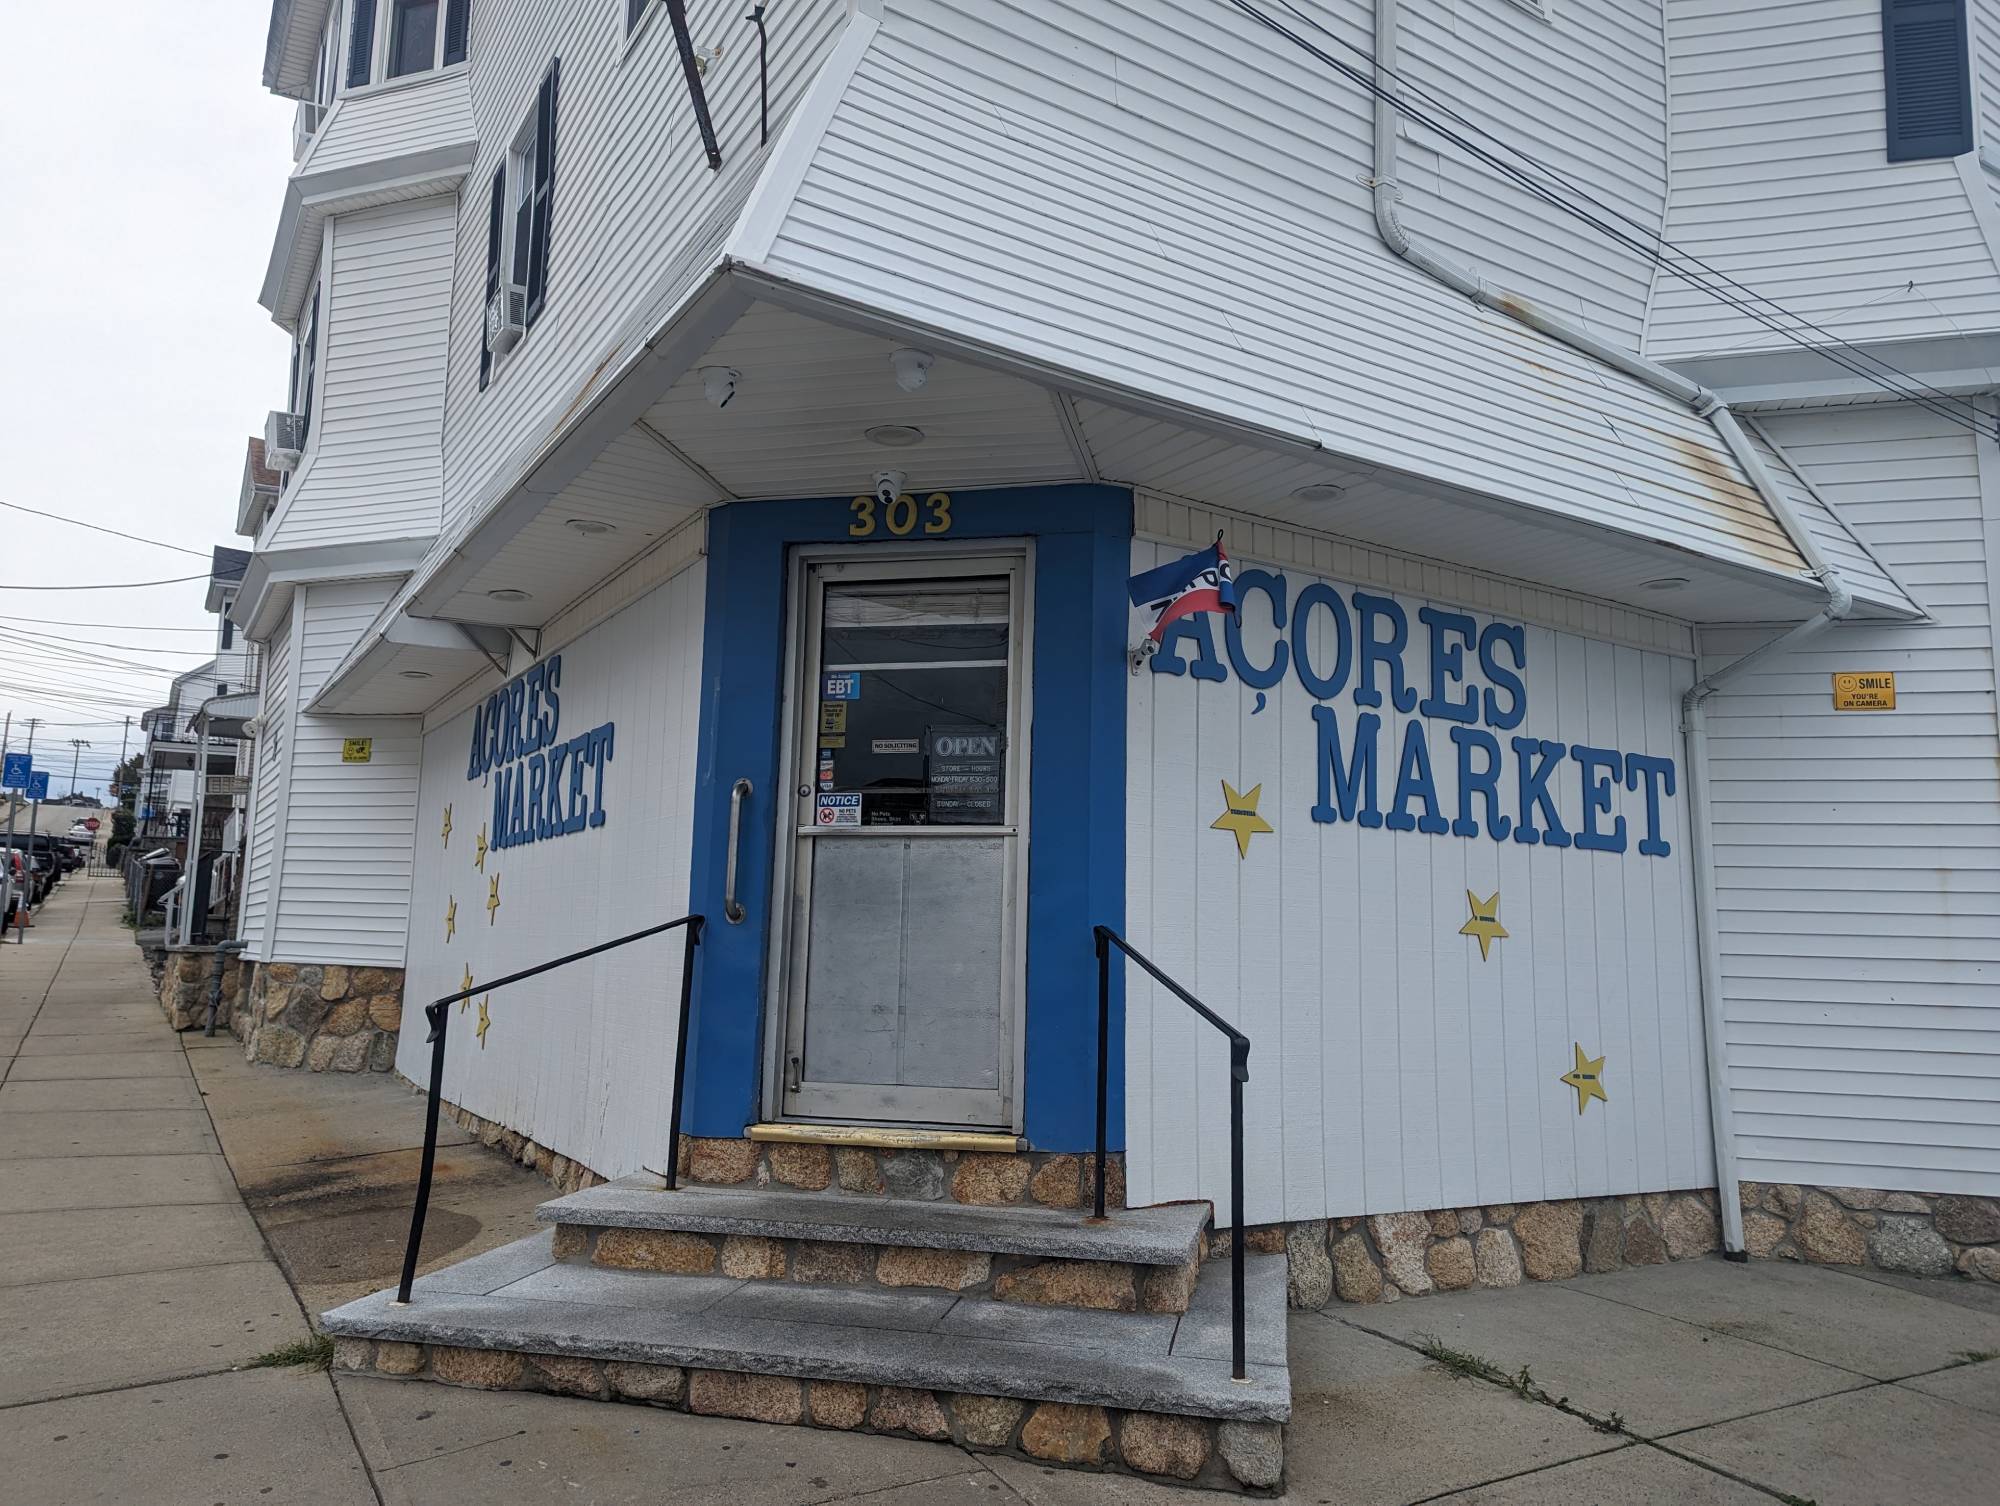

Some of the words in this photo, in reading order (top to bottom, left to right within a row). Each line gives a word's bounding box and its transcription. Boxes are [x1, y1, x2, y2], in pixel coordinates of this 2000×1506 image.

[849, 492, 952, 536] 303
[1149, 568, 1527, 729] AÇORES
[827, 679, 854, 694] EBT
[1859, 678, 1891, 689] SMILE
[935, 736, 997, 757] OPEN
[490, 721, 615, 852] MARKET
[1311, 704, 1676, 857] MARKET
[819, 796, 859, 806] NOTICE
